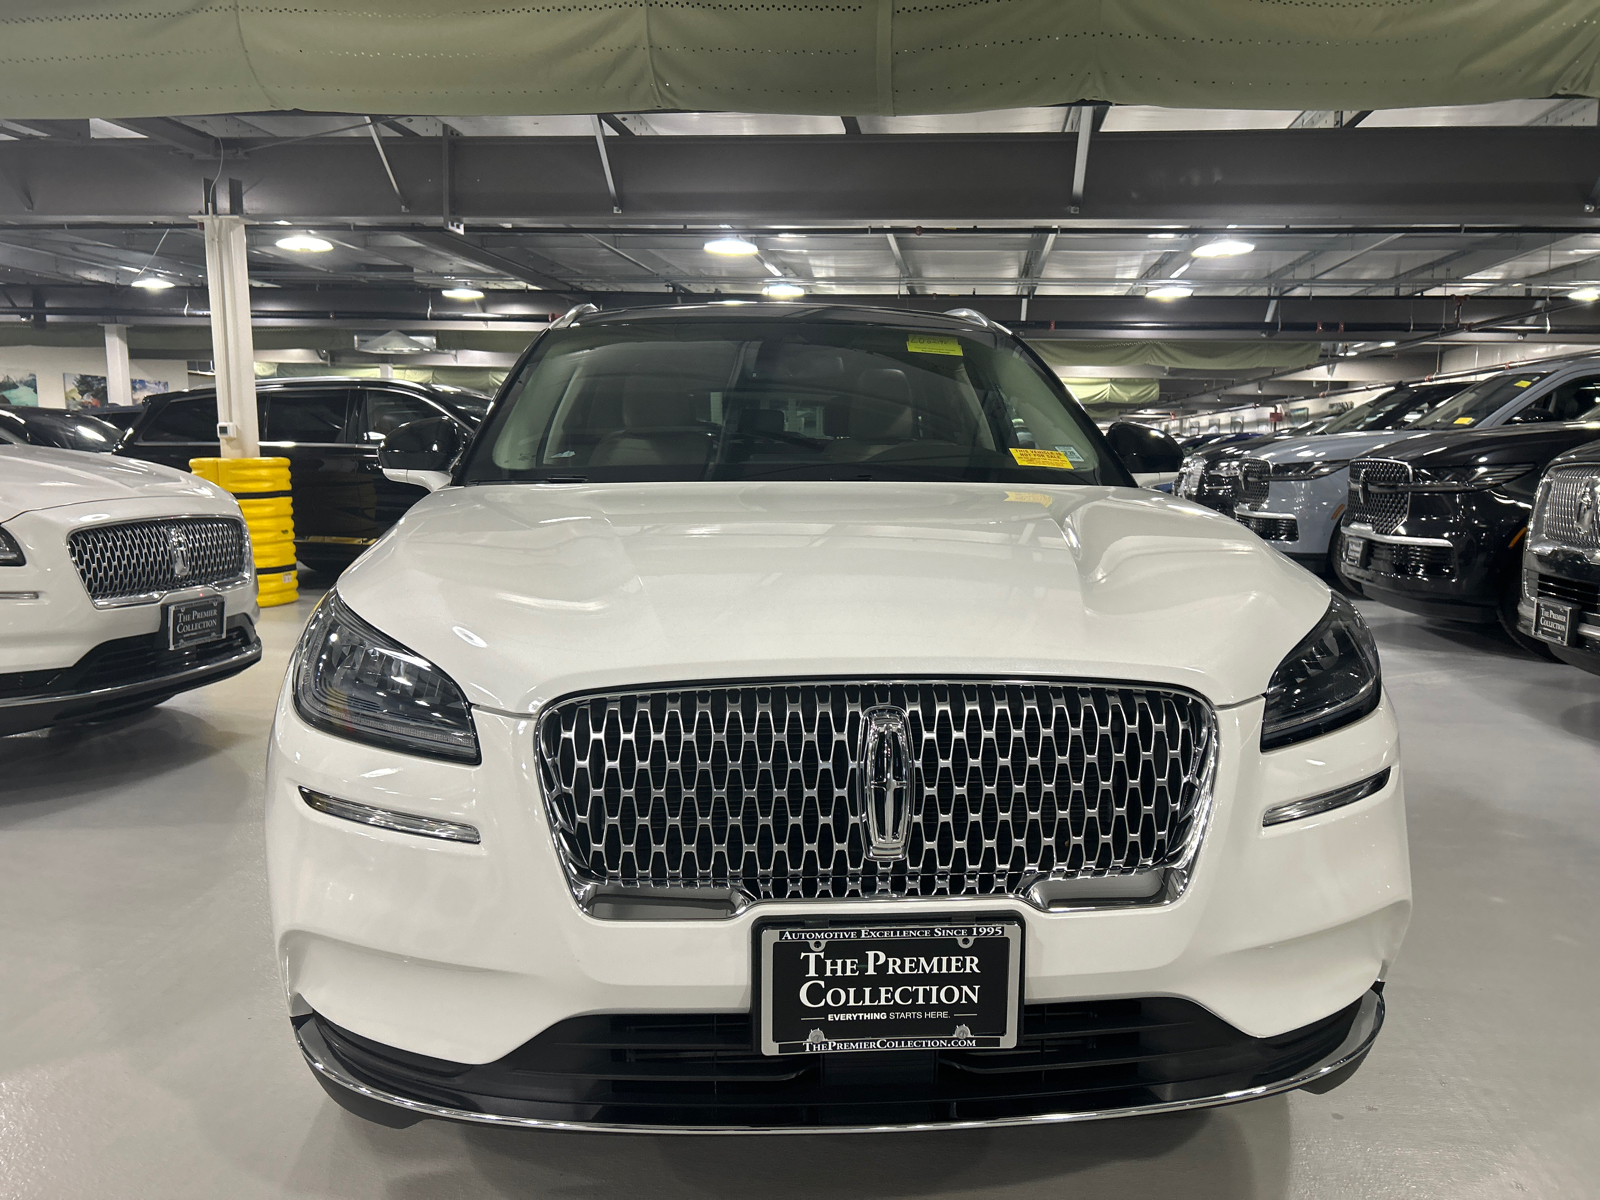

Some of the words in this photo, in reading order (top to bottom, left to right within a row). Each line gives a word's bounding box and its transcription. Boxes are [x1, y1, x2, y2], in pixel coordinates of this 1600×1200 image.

[971, 926, 1002, 937] 1995
[827, 1012, 887, 1022] EVERYTHING
[889, 1011, 922, 1020] STARTS
[924, 1010, 951, 1020] HERE.
